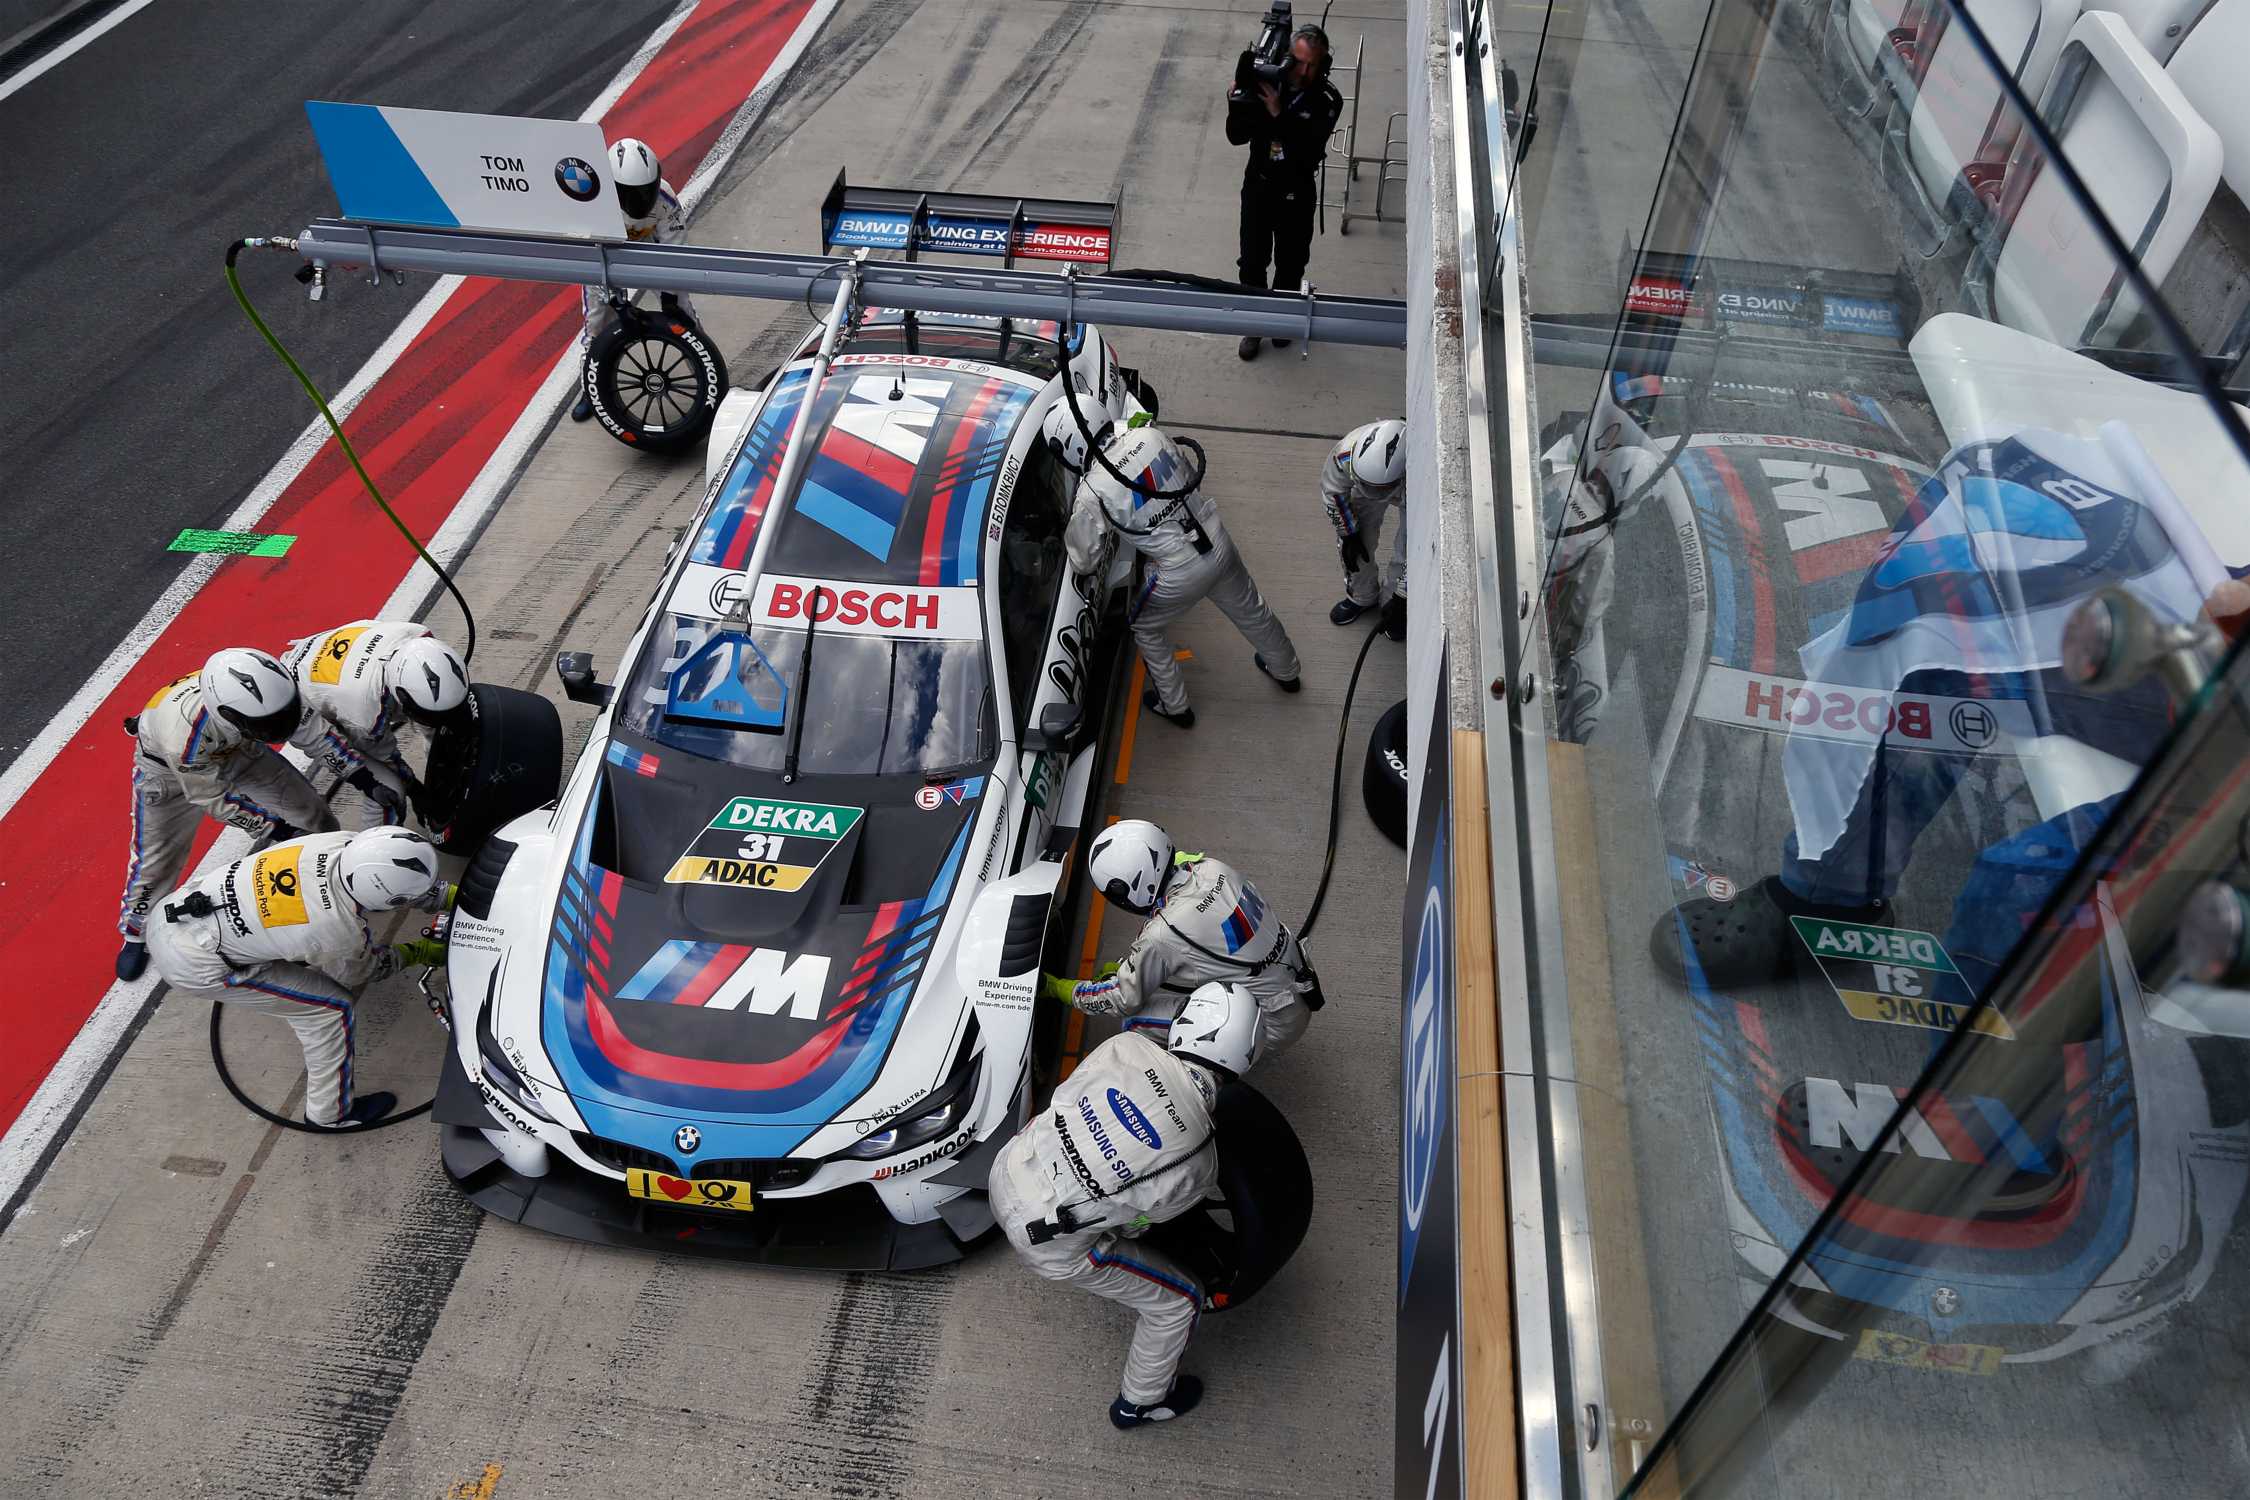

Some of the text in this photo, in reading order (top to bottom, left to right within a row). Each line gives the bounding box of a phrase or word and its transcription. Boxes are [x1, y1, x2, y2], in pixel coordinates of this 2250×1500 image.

[480, 155, 525, 172] TOM
[480, 175, 529, 193] TIMO
[840, 219, 1109, 249] BMW DVING EXERIENCE
[934, 239, 980, 250] training
[842, 353, 951, 368] BOSCH
[1114, 441, 1146, 473] MW Team
[991, 453, 1021, 525] БЛОМКВИСТ
[767, 583, 940, 631] BOSCH
[354, 634, 383, 680] BMW Team
[922, 790, 937, 806] E
[728, 801, 838, 836] DEKRA
[736, 832, 784, 863] 31
[977, 804, 1007, 884] bmw-m.com
[255, 857, 272, 919] Deutsche Post
[317, 853, 332, 910] BMW Team
[698, 859, 779, 888] ADAC
[1196, 873, 1226, 914] BMW Team
[452, 930, 496, 943] Experience
[455, 920, 505, 936] BMW Driving
[978, 979, 1033, 994] BMW Driving
[984, 990, 1032, 1003] Experience
[975, 1000, 1031, 1012] bmw-m.combde
[526, 1074, 543, 1098] ULTRA
[900, 1087, 927, 1107] ULTRA
[1144, 1068, 1187, 1132] BMW Team
[1114, 1091, 1153, 1147] SAMSUNG
[1078, 1095, 1118, 1161] SAMSUNG
[1111, 1159, 1135, 1183] SDI
